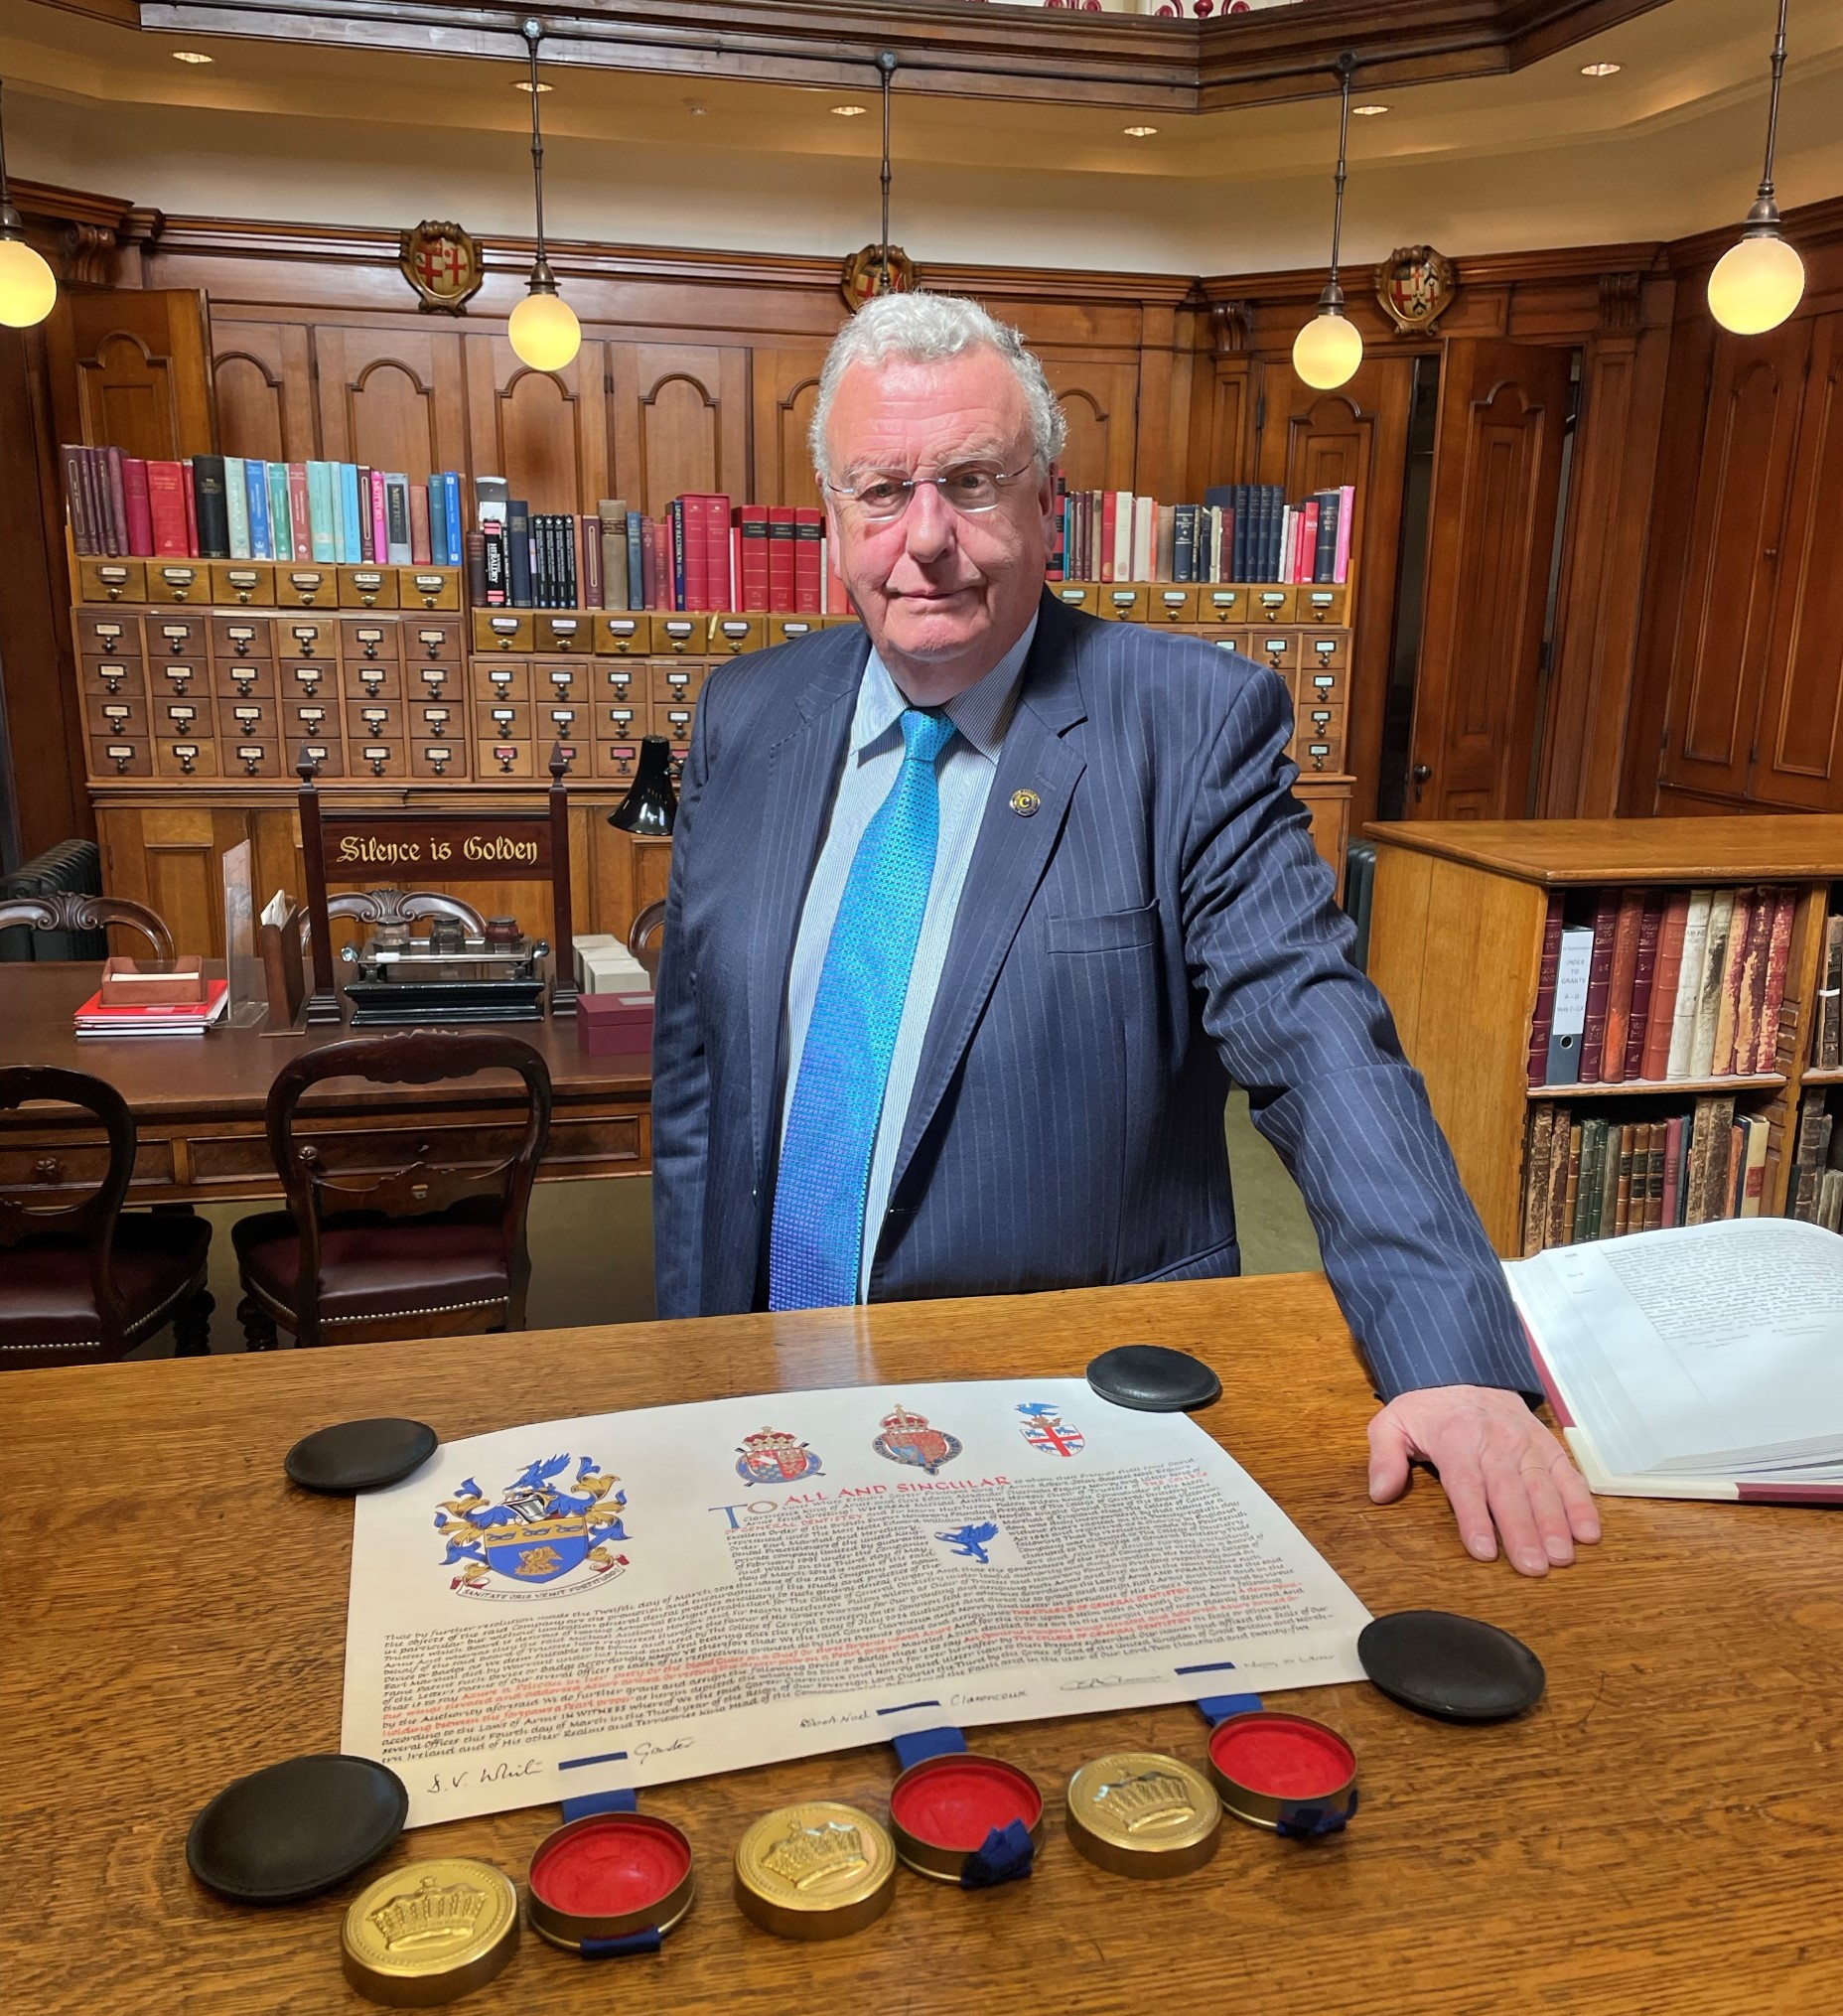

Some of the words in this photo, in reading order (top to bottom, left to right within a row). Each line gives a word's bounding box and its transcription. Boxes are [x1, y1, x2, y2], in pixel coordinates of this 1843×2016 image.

[337, 836, 420, 865] Silence
[430, 837, 452, 860] is
[463, 836, 537, 865] Golden
[708, 1501, 778, 1529] TO
[784, 1492, 827, 1506] ALL
[838, 1485, 888, 1499] AND
[897, 1477, 1011, 1493] SINGULAR
[745, 1522, 795, 1531] GENERAL
[801, 1514, 862, 1525] DENTISTRY
[727, 1531, 767, 1540] Excellent
[788, 1535, 833, 1545] Marshal
[734, 1555, 770, 1564] private
[773, 1550, 817, 1559] company
[820, 1545, 857, 1554] limited
[765, 1542, 830, 1554] Practitioners
[746, 1557, 793, 1568] February
[463, 1590, 506, 1600] SANITATE
[534, 1588, 565, 1599] VENIT
[594, 1605, 635, 1615] Twelfth
[662, 1595, 672, 1604] of
[674, 1589, 710, 1602] March
[1033, 1606, 1073, 1615] COLLEGE
[1090, 1597, 1135, 1610] GENERAL
[1136, 1587, 1190, 1602] DENTISTRY
[410, 1674, 458, 1686] Marshal
[431, 1667, 465, 1677] Badge
[421, 1709, 483, 1722] Authority
[486, 1698, 539, 1713] aforesaid
[576, 1687, 627, 1702] further
[382, 1733, 441, 1745] according
[480, 1721, 507, 1731] Laws
[524, 1716, 557, 1725] Arms
[577, 1704, 627, 1717] WITNESS
[630, 1696, 673, 1710] whereof
[382, 1724, 432, 1737] holding
[435, 1716, 479, 1729] between
[483, 1713, 500, 1722] the
[382, 1755, 402, 1764] ern
[407, 1748, 455, 1761] Ireland
[459, 1744, 485, 1753] and
[501, 1738, 524, 1748] His
[525, 1732, 559, 1743] other
[563, 1726, 605, 1738] Realms
[608, 1722, 633, 1731] and
[637, 1710, 696, 1726] Territories
[729, 1698, 758, 1710] Head
[761, 1694, 770, 1703] of
[382, 1744, 421, 1755] several
[425, 1738, 463, 1749] Offices
[490, 1728, 528, 1739] Fourth
[531, 1725, 553, 1734] day
[556, 1722, 567, 1731] of
[569, 1717, 608, 1728] March
[626, 1711, 643, 1720] the
[646, 1706, 679, 1717] Third
